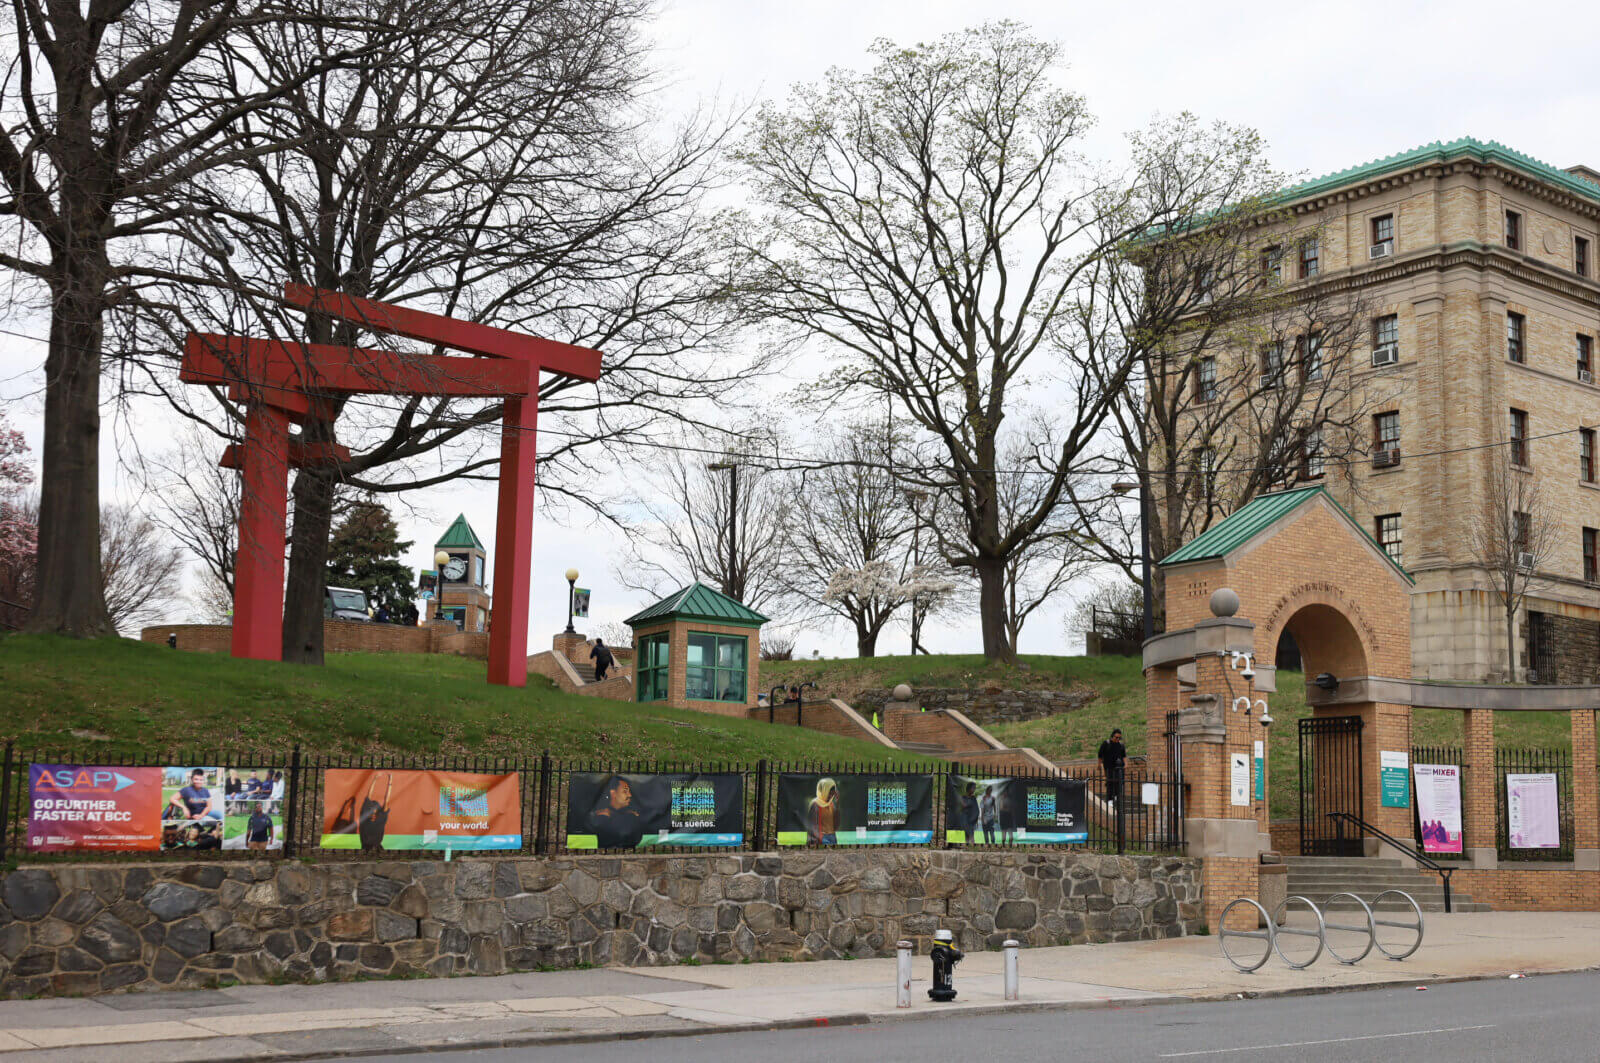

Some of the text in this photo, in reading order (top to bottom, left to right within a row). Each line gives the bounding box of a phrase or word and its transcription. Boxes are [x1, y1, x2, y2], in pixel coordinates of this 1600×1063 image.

[1432, 768, 1456, 776] MIXER
[35, 770, 113, 787] ASAP
[34, 799, 116, 810] GO FURTHER
[34, 811, 132, 821] FASTER AT BCC
[440, 821, 490, 831] your world.
[671, 820, 716, 828] tus sueños.
